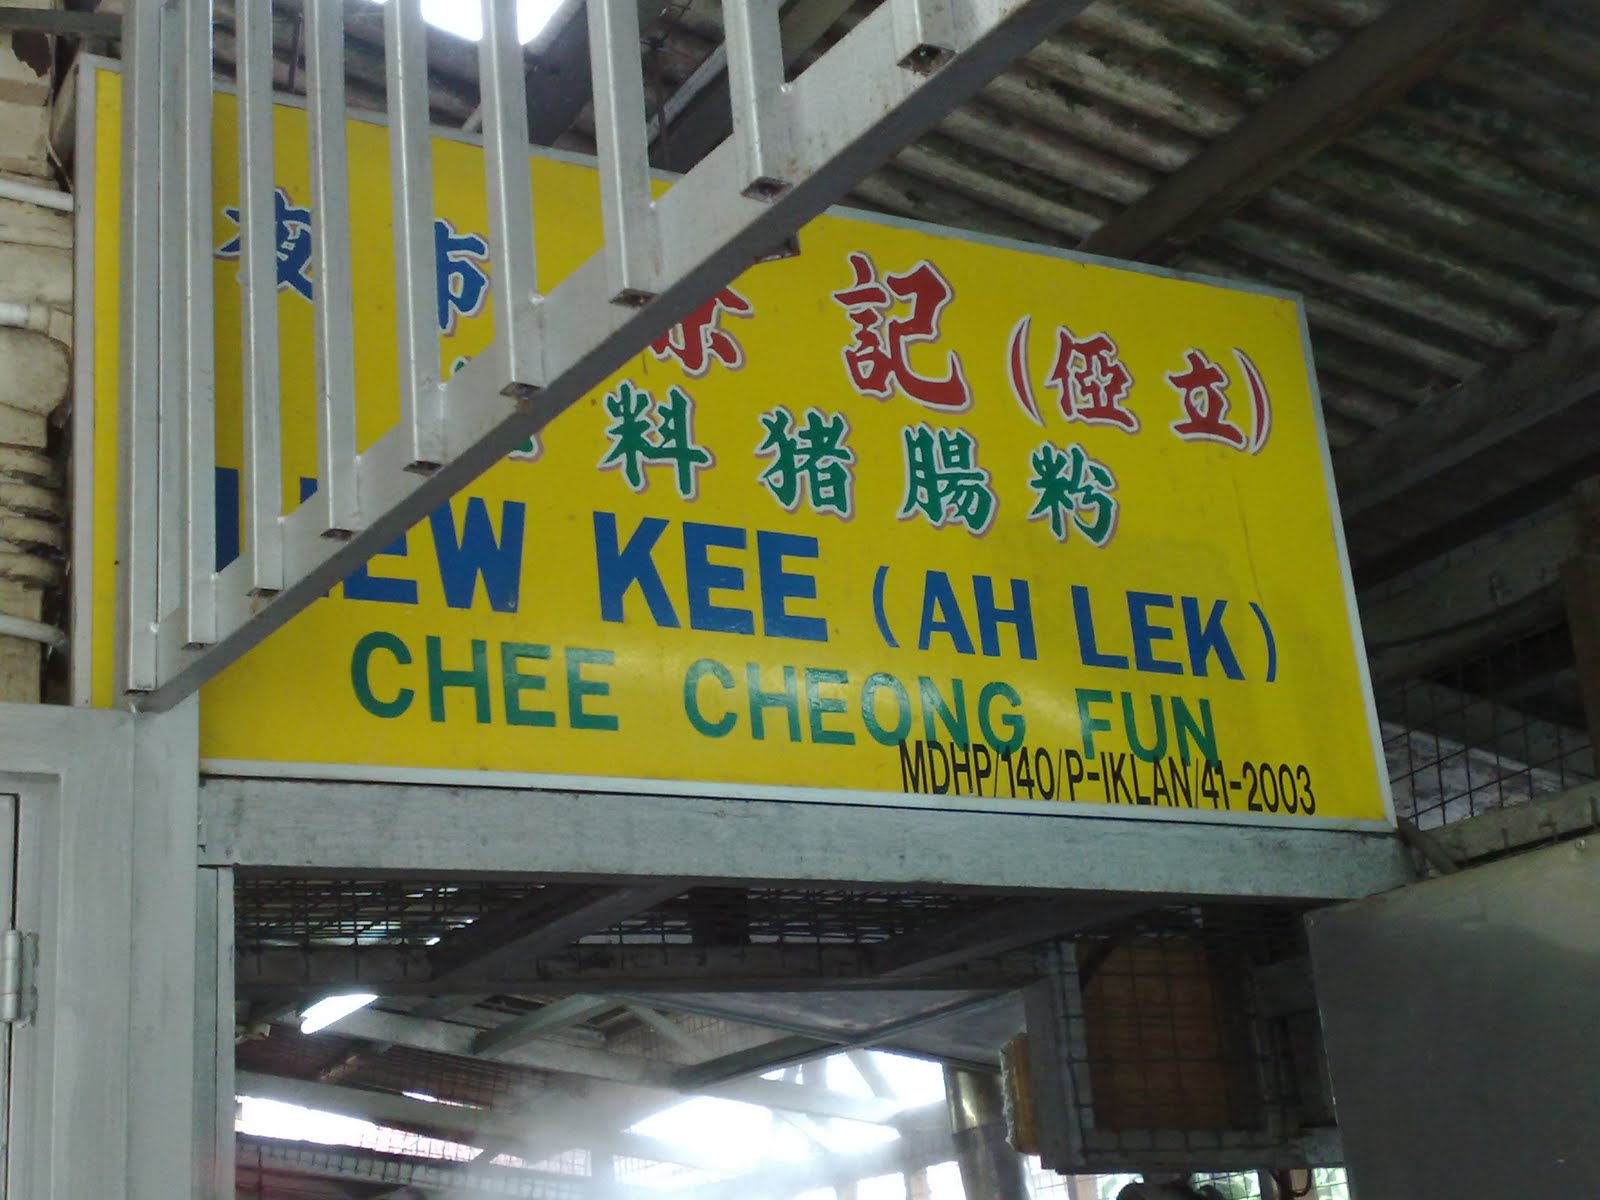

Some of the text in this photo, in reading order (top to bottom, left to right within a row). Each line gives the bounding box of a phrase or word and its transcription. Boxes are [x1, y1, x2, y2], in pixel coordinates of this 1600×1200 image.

[508, 374, 1118, 547] 料猪腸粉
[593, 511, 828, 642] KEE
[872, 566, 1037, 660] (AH
[1071, 585, 1276, 682] LEK)
[351, 631, 1219, 768] CHEE CHEONG FUN
